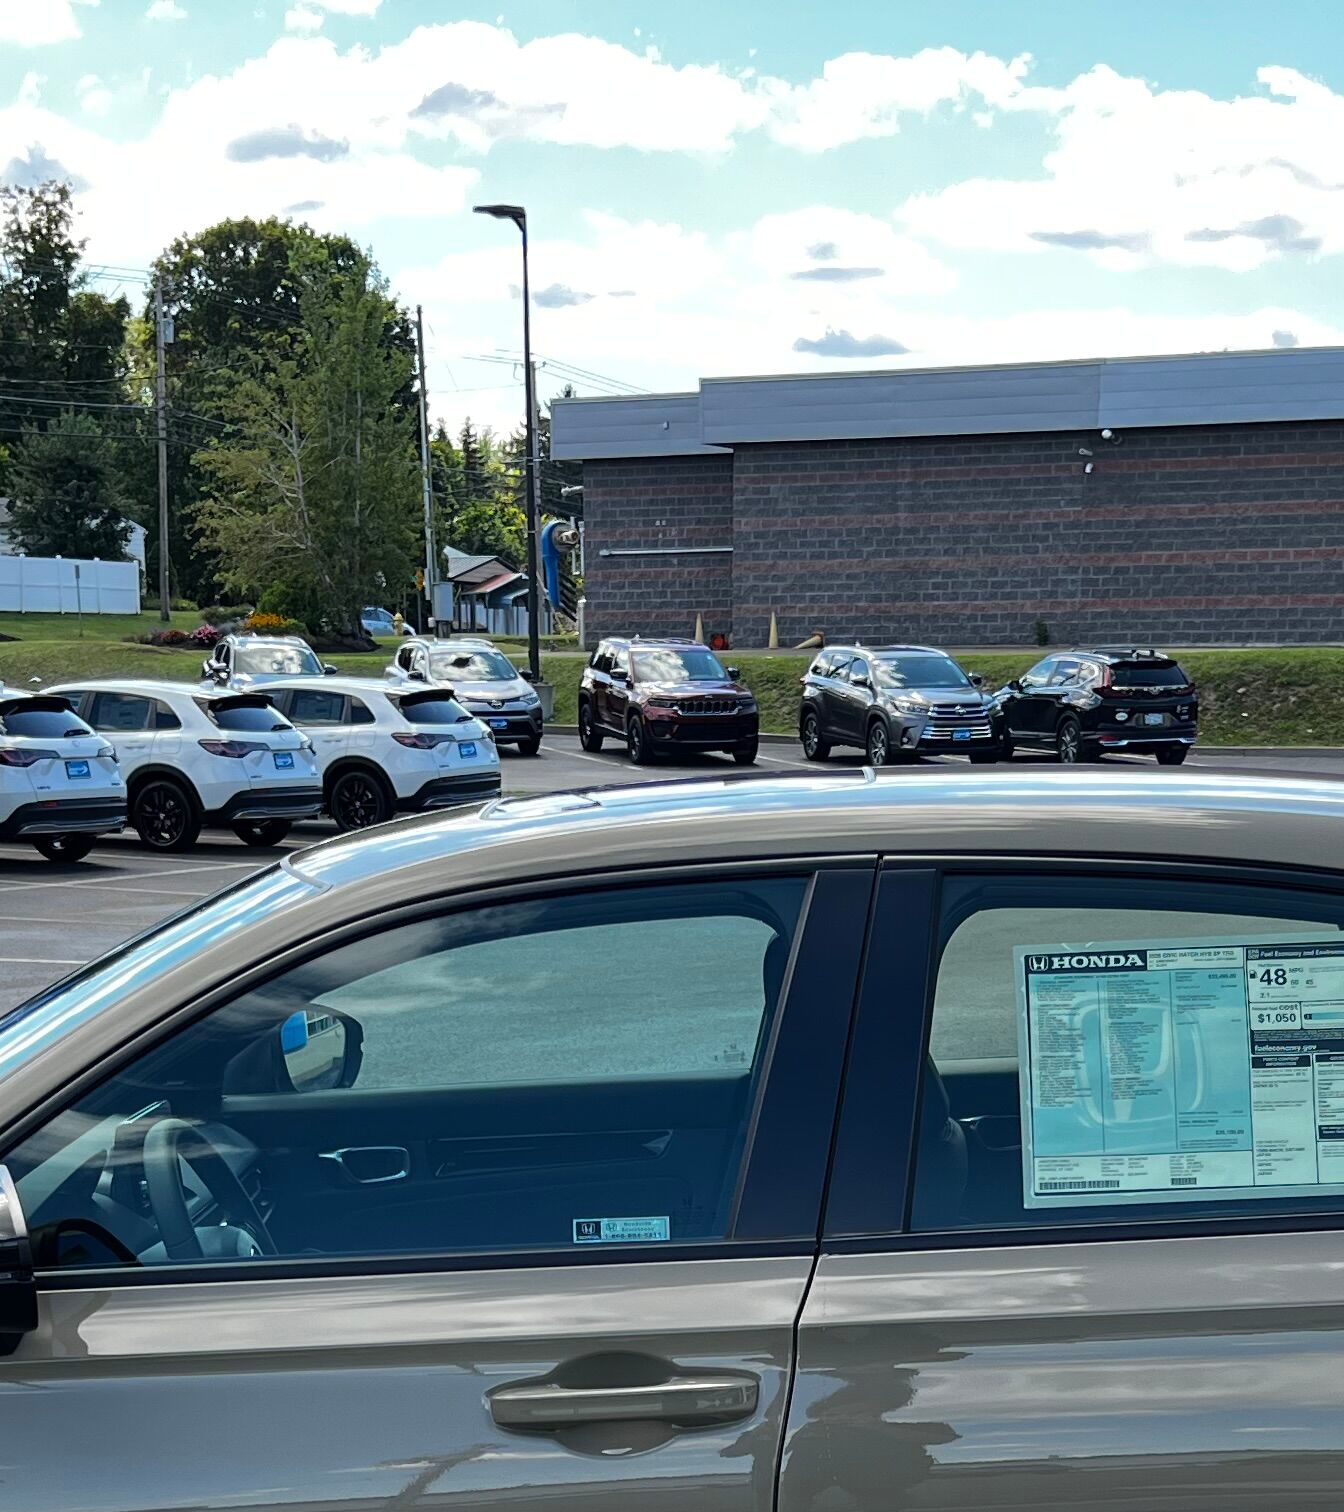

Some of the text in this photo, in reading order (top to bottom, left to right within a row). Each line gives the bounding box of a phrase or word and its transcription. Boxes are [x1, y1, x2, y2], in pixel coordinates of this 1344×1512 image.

[1051, 953, 1145, 970] HONDA
[1259, 968, 1288, 986] 48
[1278, 1003, 1299, 1011] cost
[1257, 1013, 1297, 1025] $1,050
